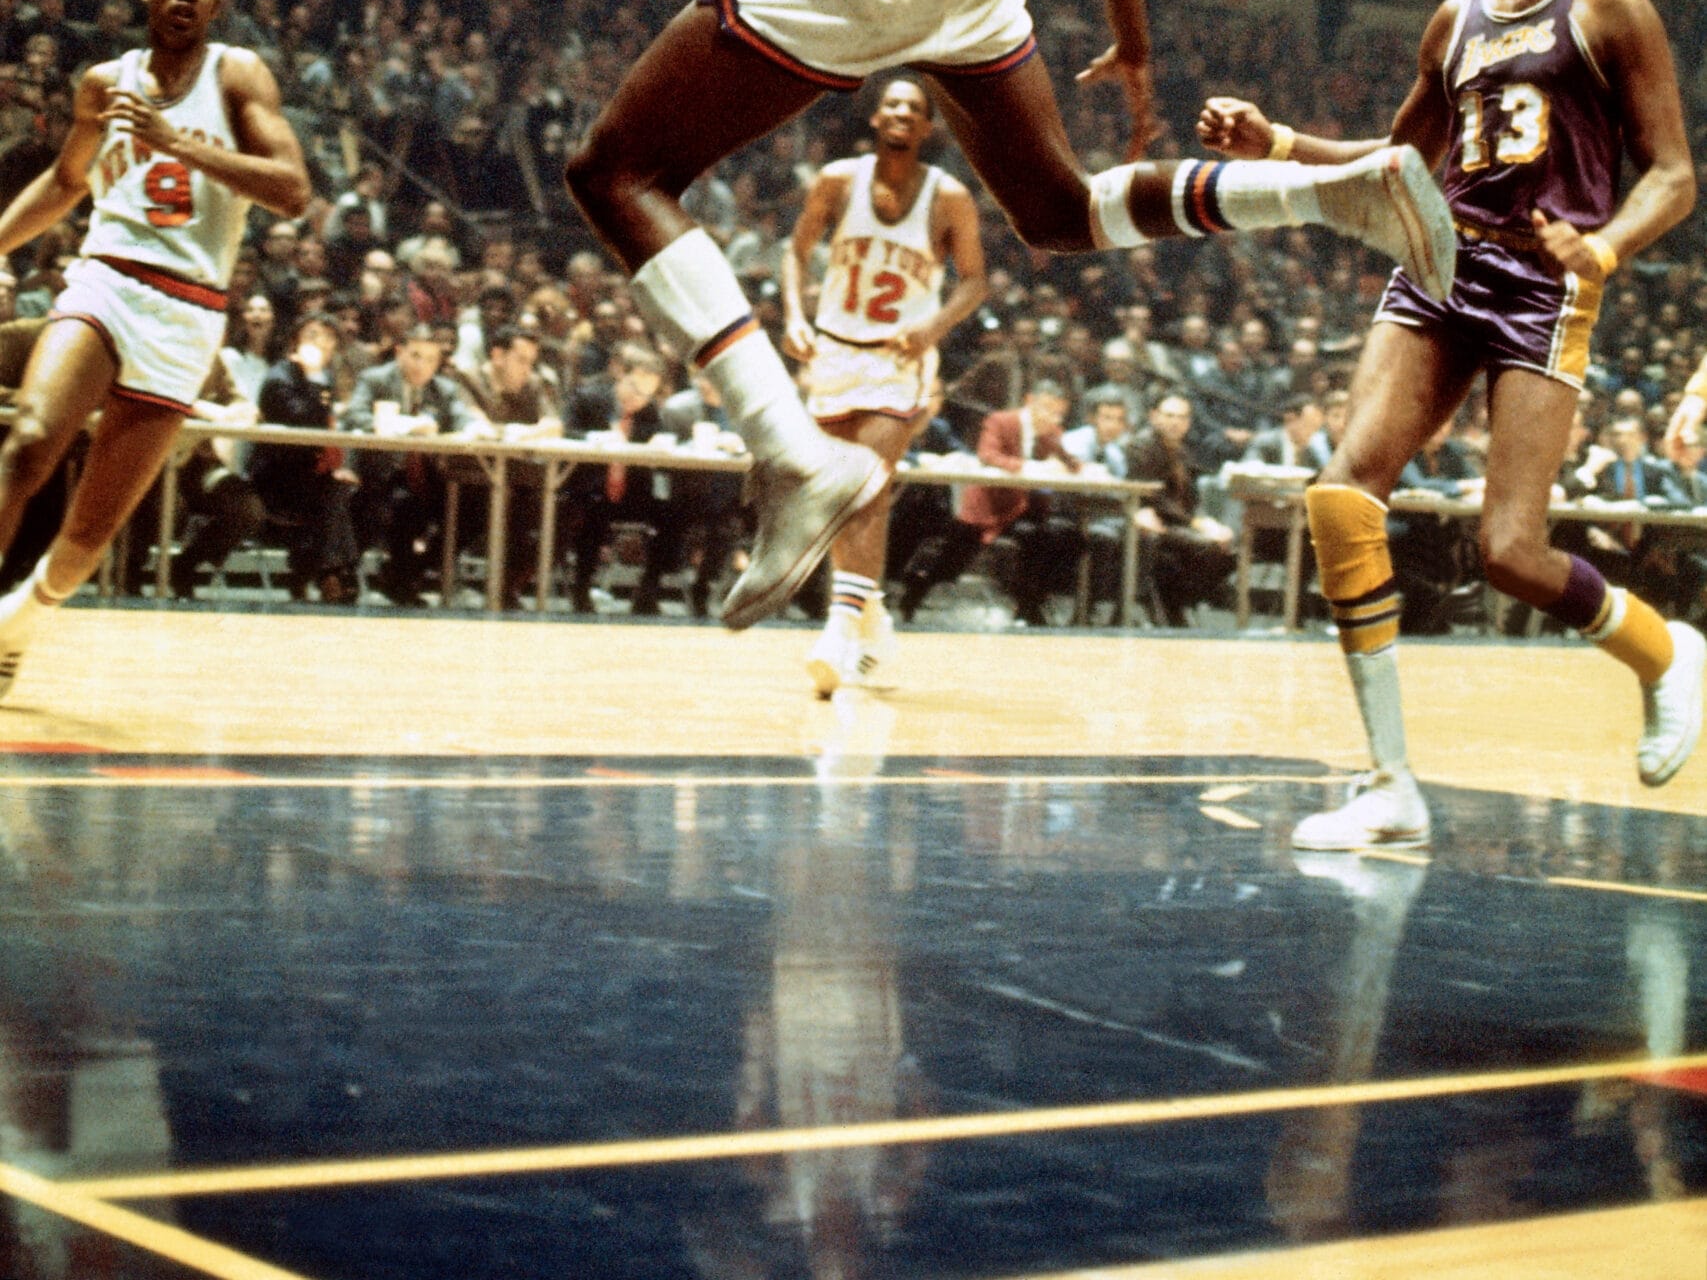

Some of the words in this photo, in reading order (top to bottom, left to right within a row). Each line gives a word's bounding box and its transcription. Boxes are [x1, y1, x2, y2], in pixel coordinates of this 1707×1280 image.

[1459, 83, 1550, 172] 13
[145, 162, 193, 228] 9
[844, 263, 907, 324] 12
